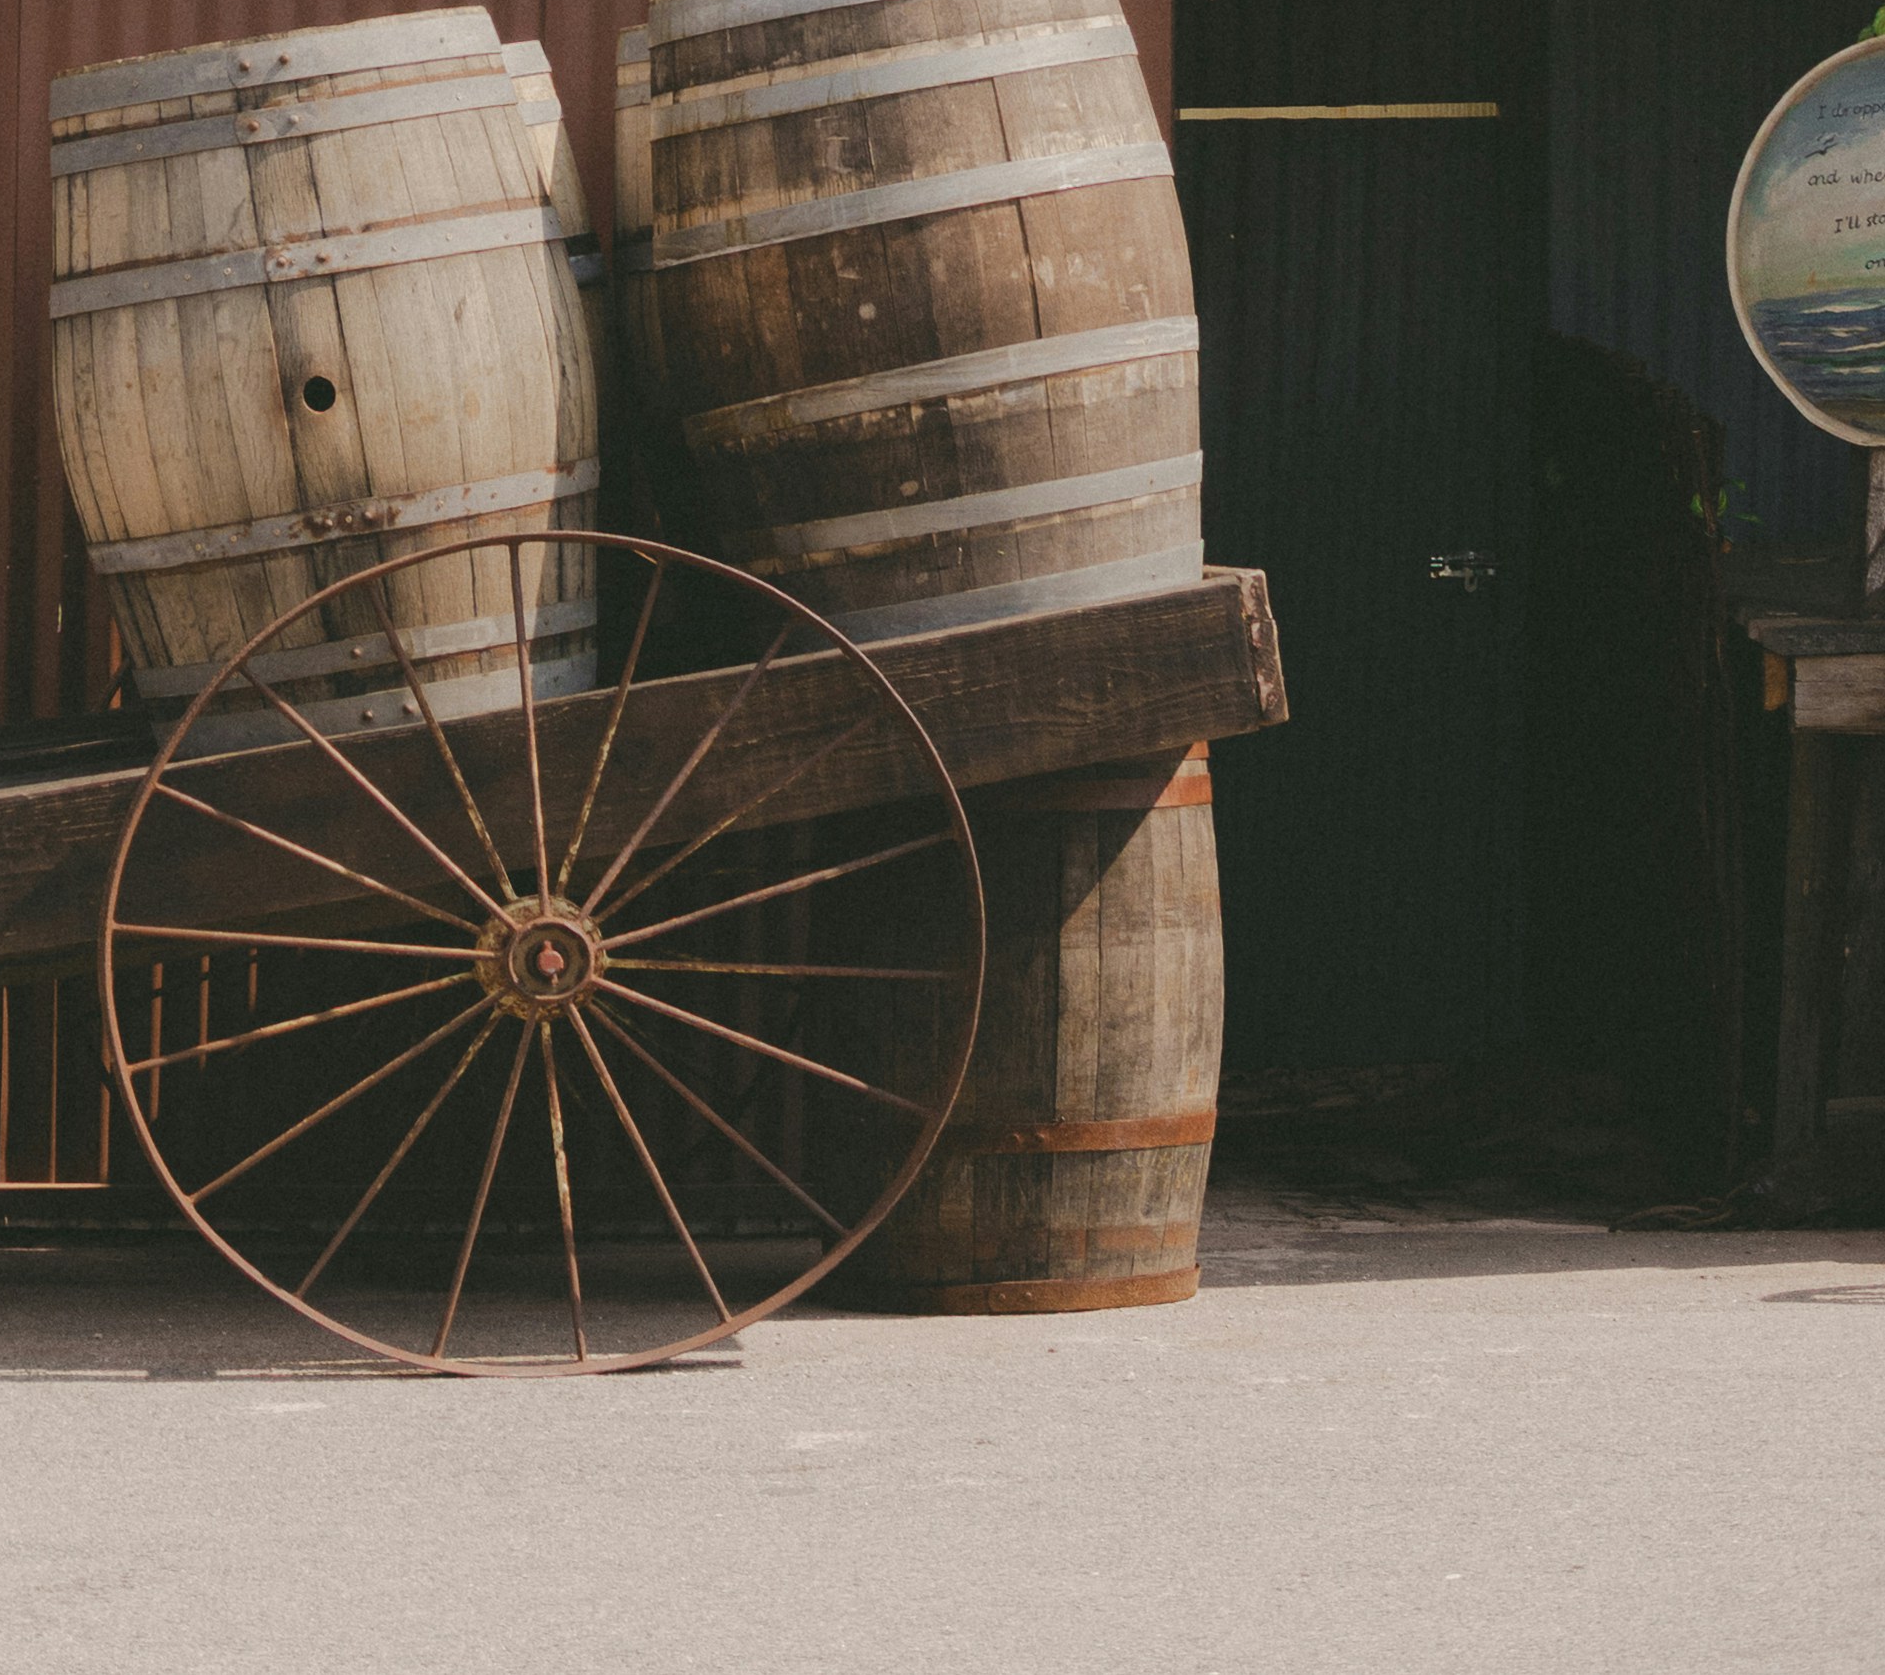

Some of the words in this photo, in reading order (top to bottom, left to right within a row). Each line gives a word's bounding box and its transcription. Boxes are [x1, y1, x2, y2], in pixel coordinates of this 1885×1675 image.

[1817, 105, 1827, 120] I
[1807, 169, 1841, 186] and
[1834, 215, 1860, 234] I'll
